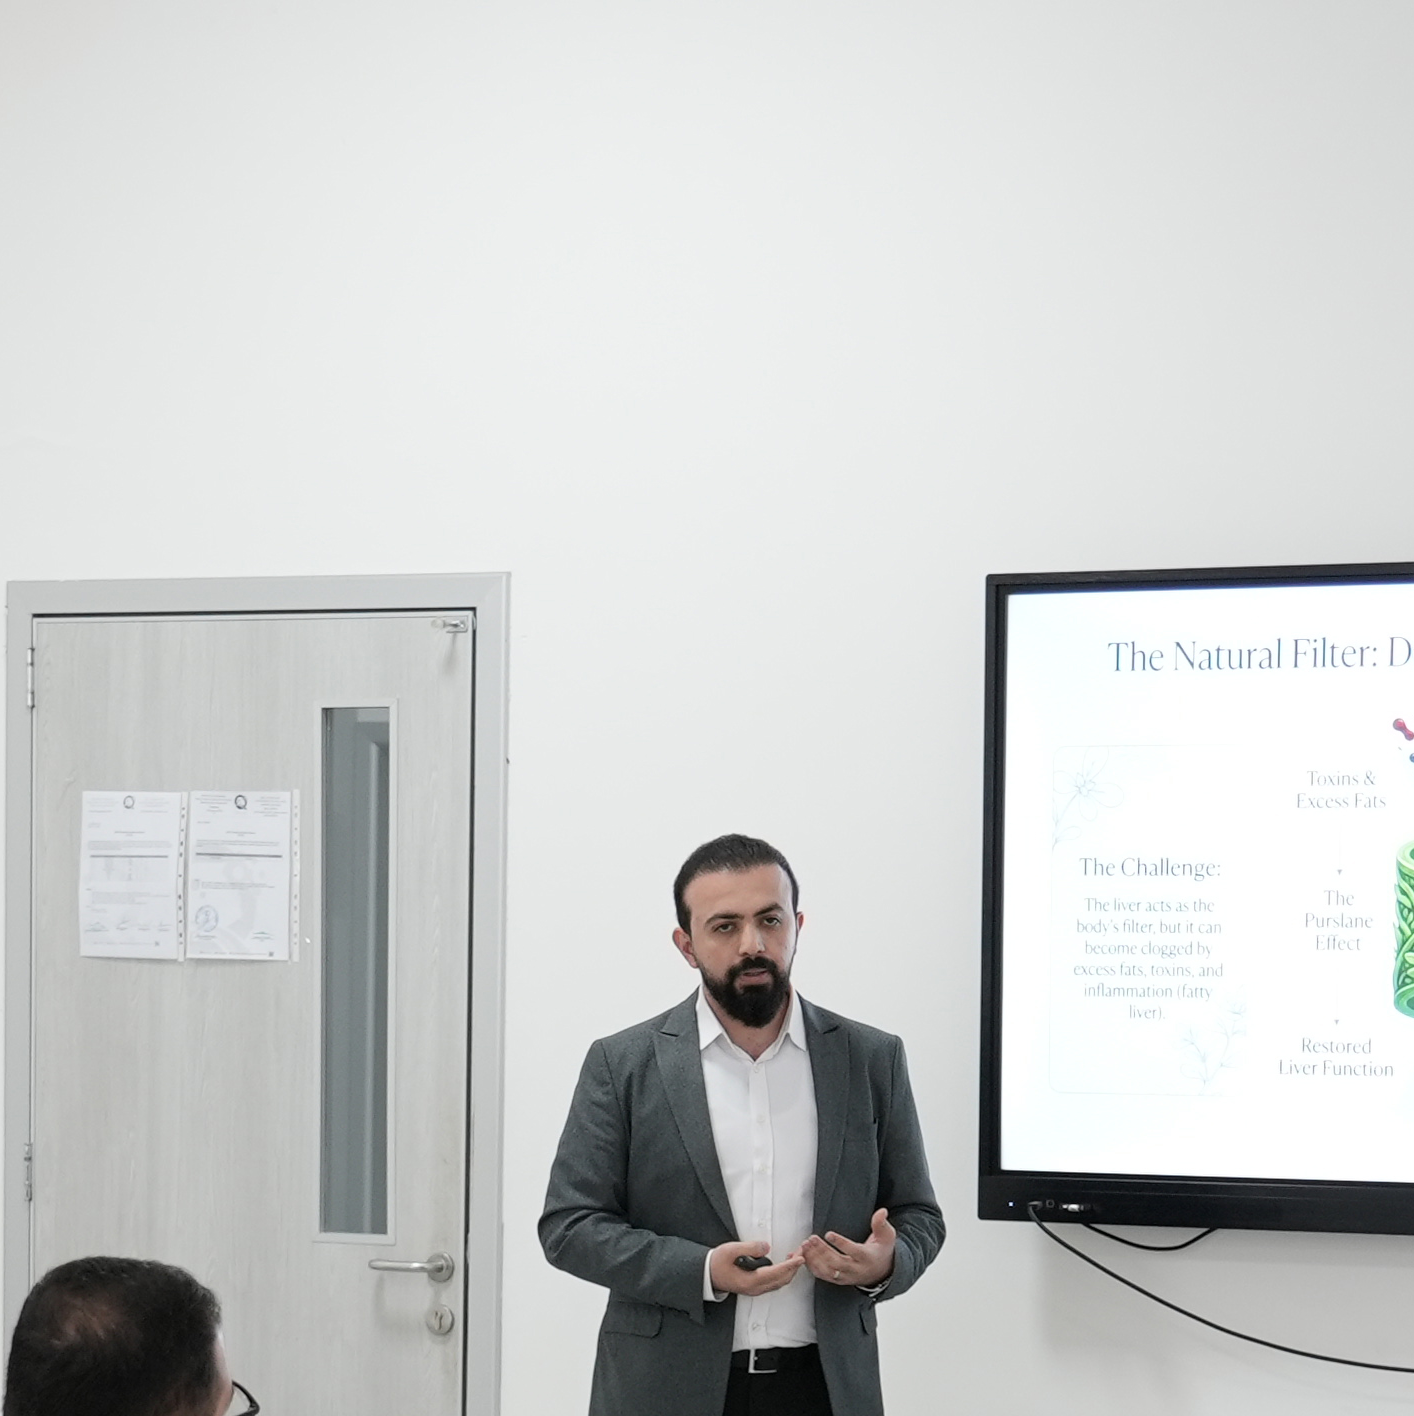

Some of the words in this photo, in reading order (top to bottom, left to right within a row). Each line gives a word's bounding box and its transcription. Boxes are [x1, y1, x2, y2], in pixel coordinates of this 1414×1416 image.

[1107, 641, 1164, 672] The
[1174, 638, 1282, 671] Natural
[1293, 637, 1377, 669] Filter:
[1307, 770, 1359, 786] Toxins
[1364, 770, 1376, 786] &
[1297, 793, 1349, 809] Excess
[1354, 793, 1387, 809] Fats
[1079, 857, 1115, 876] The
[1121, 857, 1221, 882] Challenge:
[1084, 898, 1110, 912] The
[1113, 898, 1141, 912] liver
[1145, 900, 1172, 912] acts
[1175, 901, 1189, 912] as
[1193, 899, 1215, 912] the
[1324, 890, 1354, 906] The
[1123, 919, 1156, 934] filter,
[1159, 919, 1181, 934] but
[1186, 920, 1193, 934] it
[1198, 923, 1222, 934] can
[1305, 912, 1373, 928] Purslane
[1085, 941, 1137, 955] become
[1141, 941, 1193, 959] clogged
[1197, 941, 1212, 959] by
[1316, 934, 1361, 951] Effect
[1073, 965, 1116, 976] excess
[1120, 961, 1147, 978] fats,
[1151, 963, 1195, 978] toxins,
[1198, 963, 1223, 977] and
[1084, 982, 1173, 997] inflammation
[1177, 984, 1213, 1001] (fatty
[1129, 1004, 1165, 1020] liver).
[1302, 1037, 1372, 1054] Restored
[1279, 1059, 1318, 1075] Liver
[1323, 1060, 1394, 1077] Function
